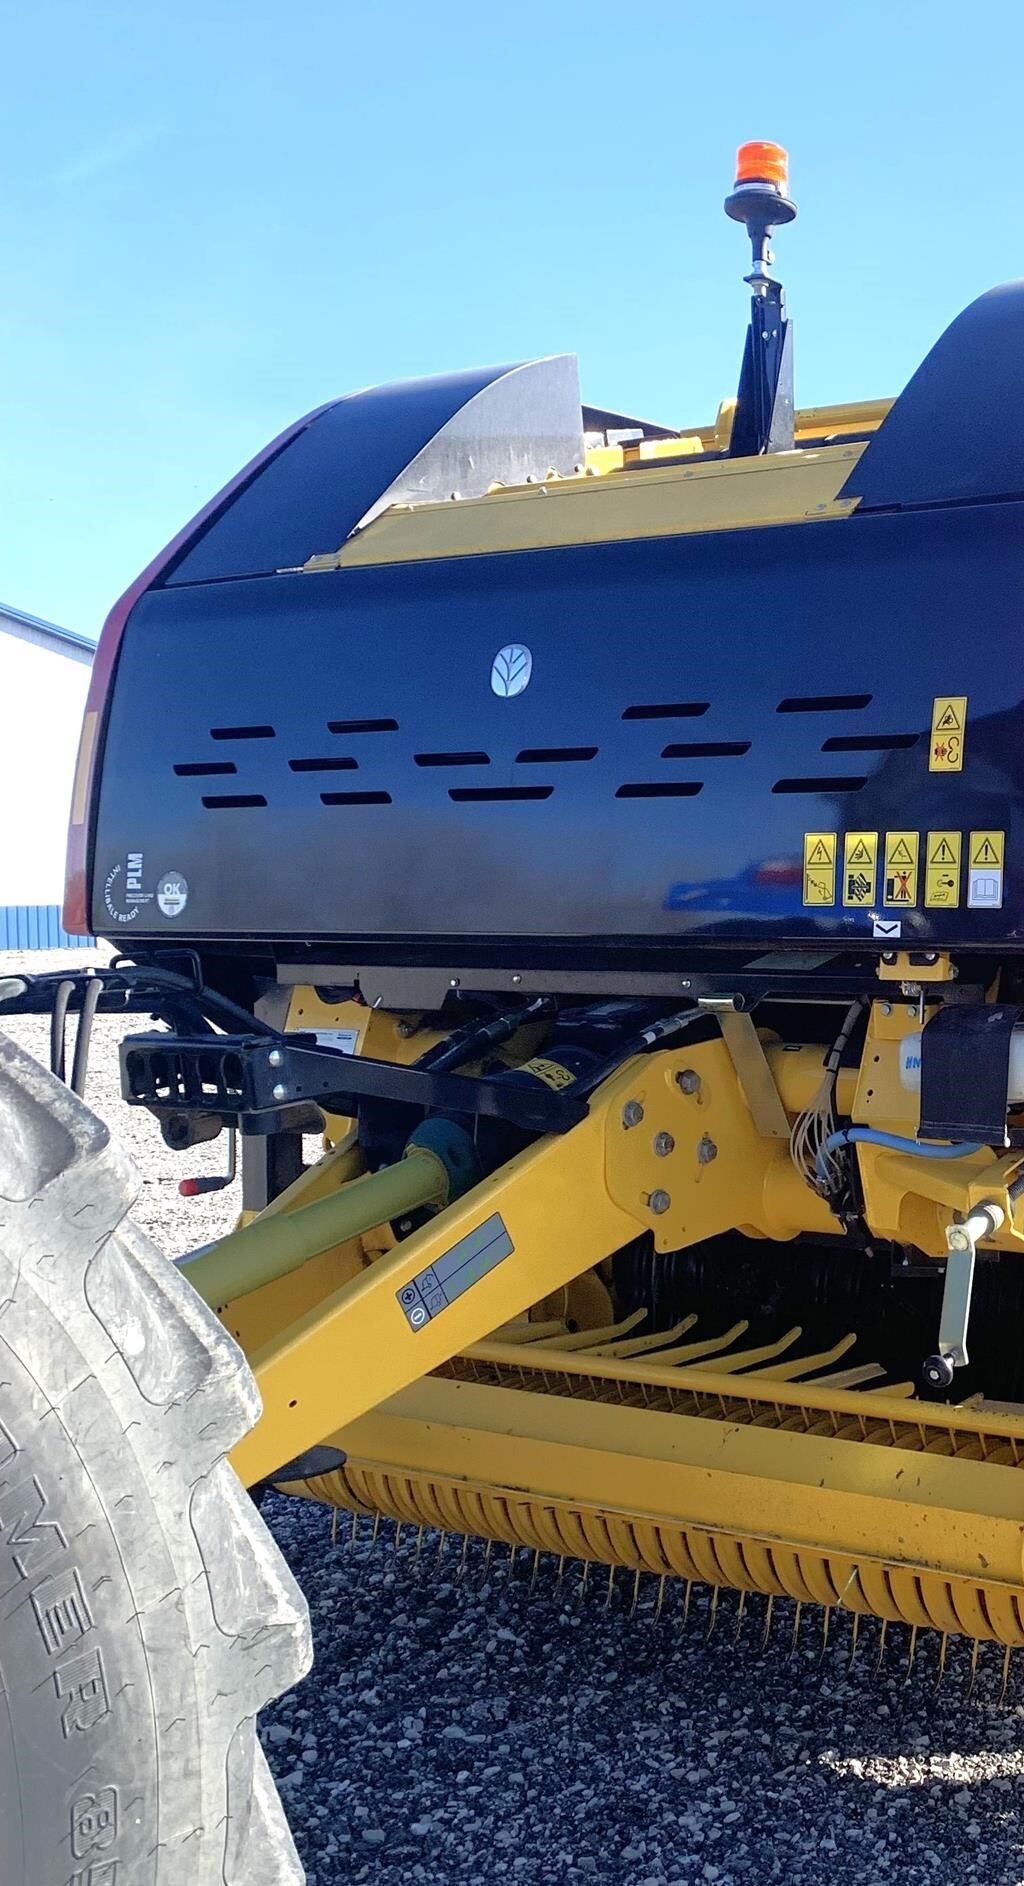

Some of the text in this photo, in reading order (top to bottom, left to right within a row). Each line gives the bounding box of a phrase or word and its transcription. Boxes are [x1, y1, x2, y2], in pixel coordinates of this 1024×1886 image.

[127, 853, 143, 889] PLM
[164, 883, 181, 896] OK
[118, 905, 140, 922] READY
